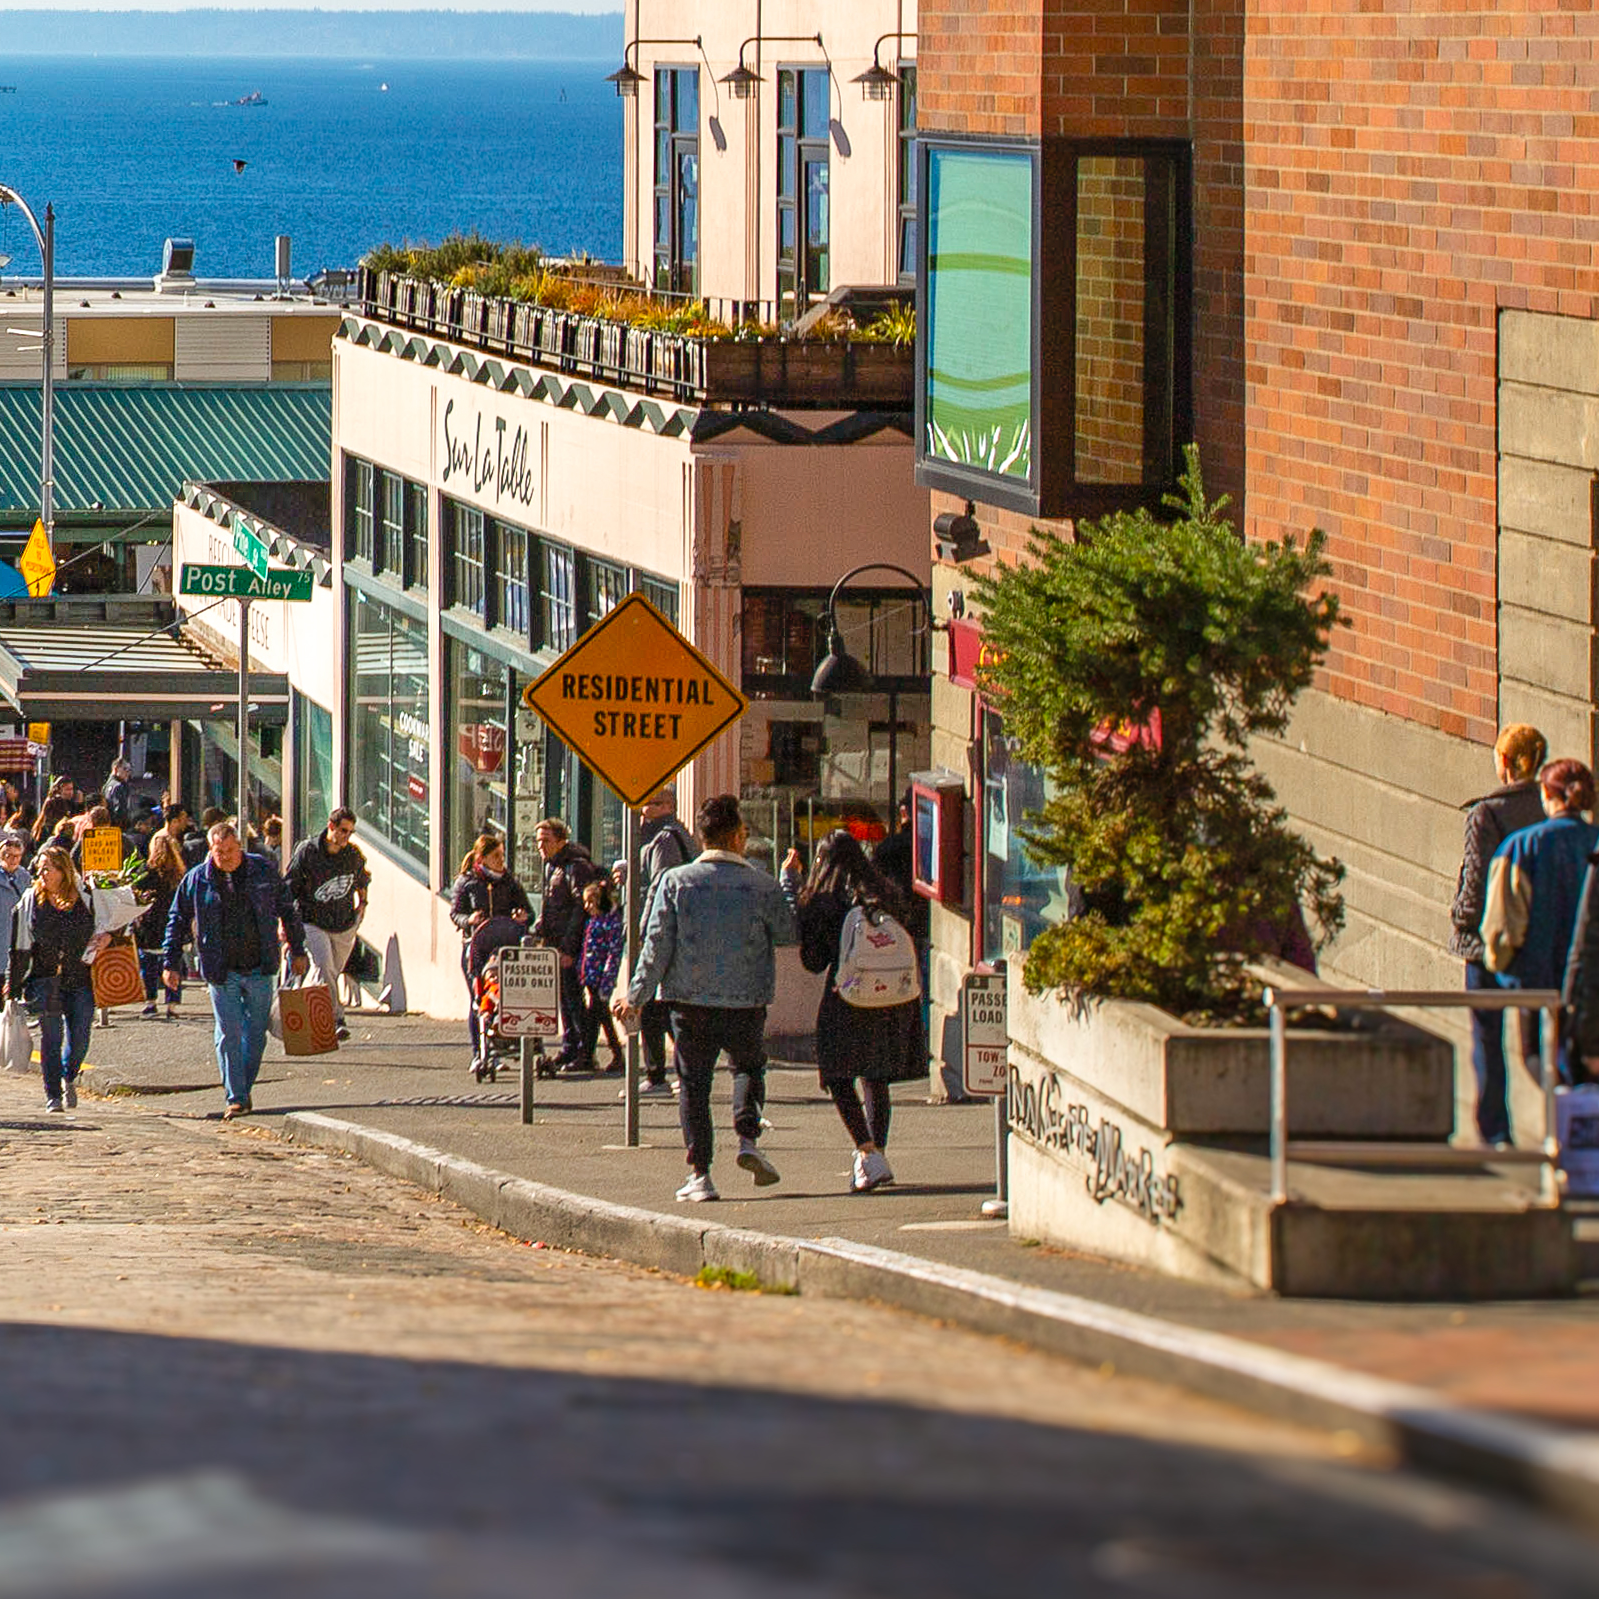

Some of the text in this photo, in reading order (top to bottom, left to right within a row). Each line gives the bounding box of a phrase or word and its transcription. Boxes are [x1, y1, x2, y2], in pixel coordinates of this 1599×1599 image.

[442, 398, 535, 507] Sur La Table
[186, 566, 311, 599] Post Alley 75
[562, 673, 715, 706] RESIDENTIAL
[594, 711, 683, 740] STREET
[408, 738, 424, 763] SALE
[507, 950, 515, 960] 3
[504, 964, 554, 976] PASSENGER
[504, 977, 554, 988] LOAD ONLY
[971, 992, 1007, 1007] PASSE
[972, 1009, 1003, 1024] LOAD
[993, 1065, 1006, 1078] ZO
